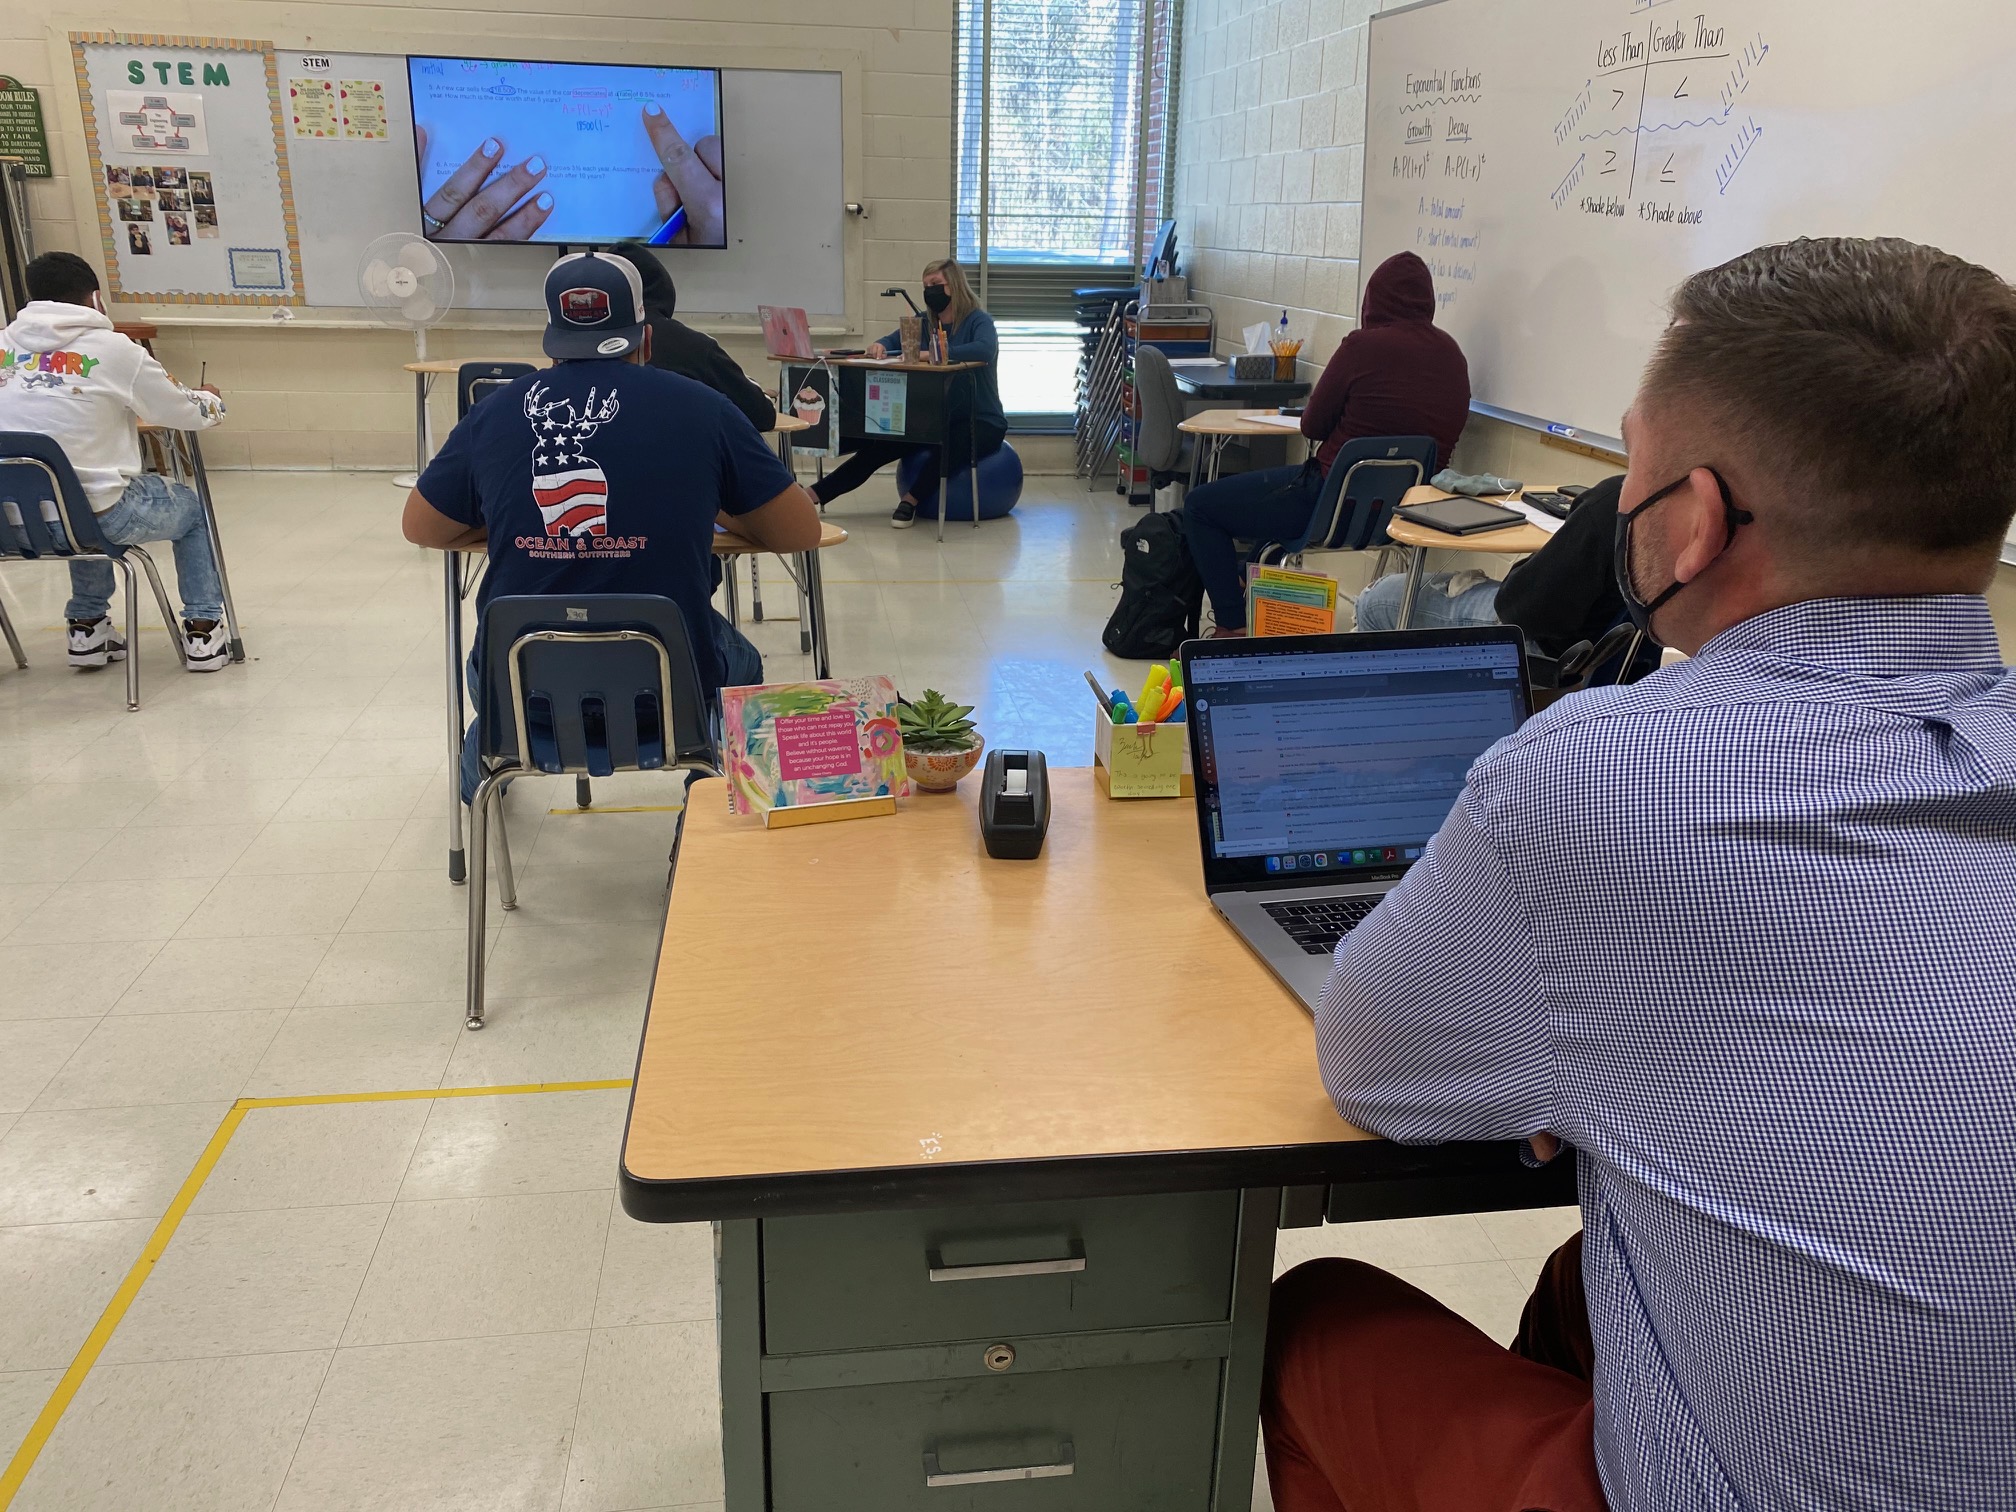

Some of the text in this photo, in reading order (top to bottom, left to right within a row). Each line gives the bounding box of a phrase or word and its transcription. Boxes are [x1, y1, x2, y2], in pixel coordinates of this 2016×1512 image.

[1653, 14, 1724, 53] Greater Than
[1597, 32, 1644, 67] Less Than
[303, 58, 330, 68] STEM
[127, 60, 230, 87] STEM
[1406, 67, 1481, 99] Exponential Functions
[14, 91, 35, 102] RULES
[1407, 117, 1433, 139] Growth
[1448, 116, 1470, 143] Decay
[25, 164, 46, 174] BEST!
[1678, 205, 1703, 224] above
[24, 351, 100, 378] JERRY
[873, 376, 901, 384] CLASSROOM
[514, 536, 648, 551] OCEAN & COAST
[528, 550, 631, 559] SOUTHERN OUTFITTERS
[802, 763, 835, 771] unchanging
